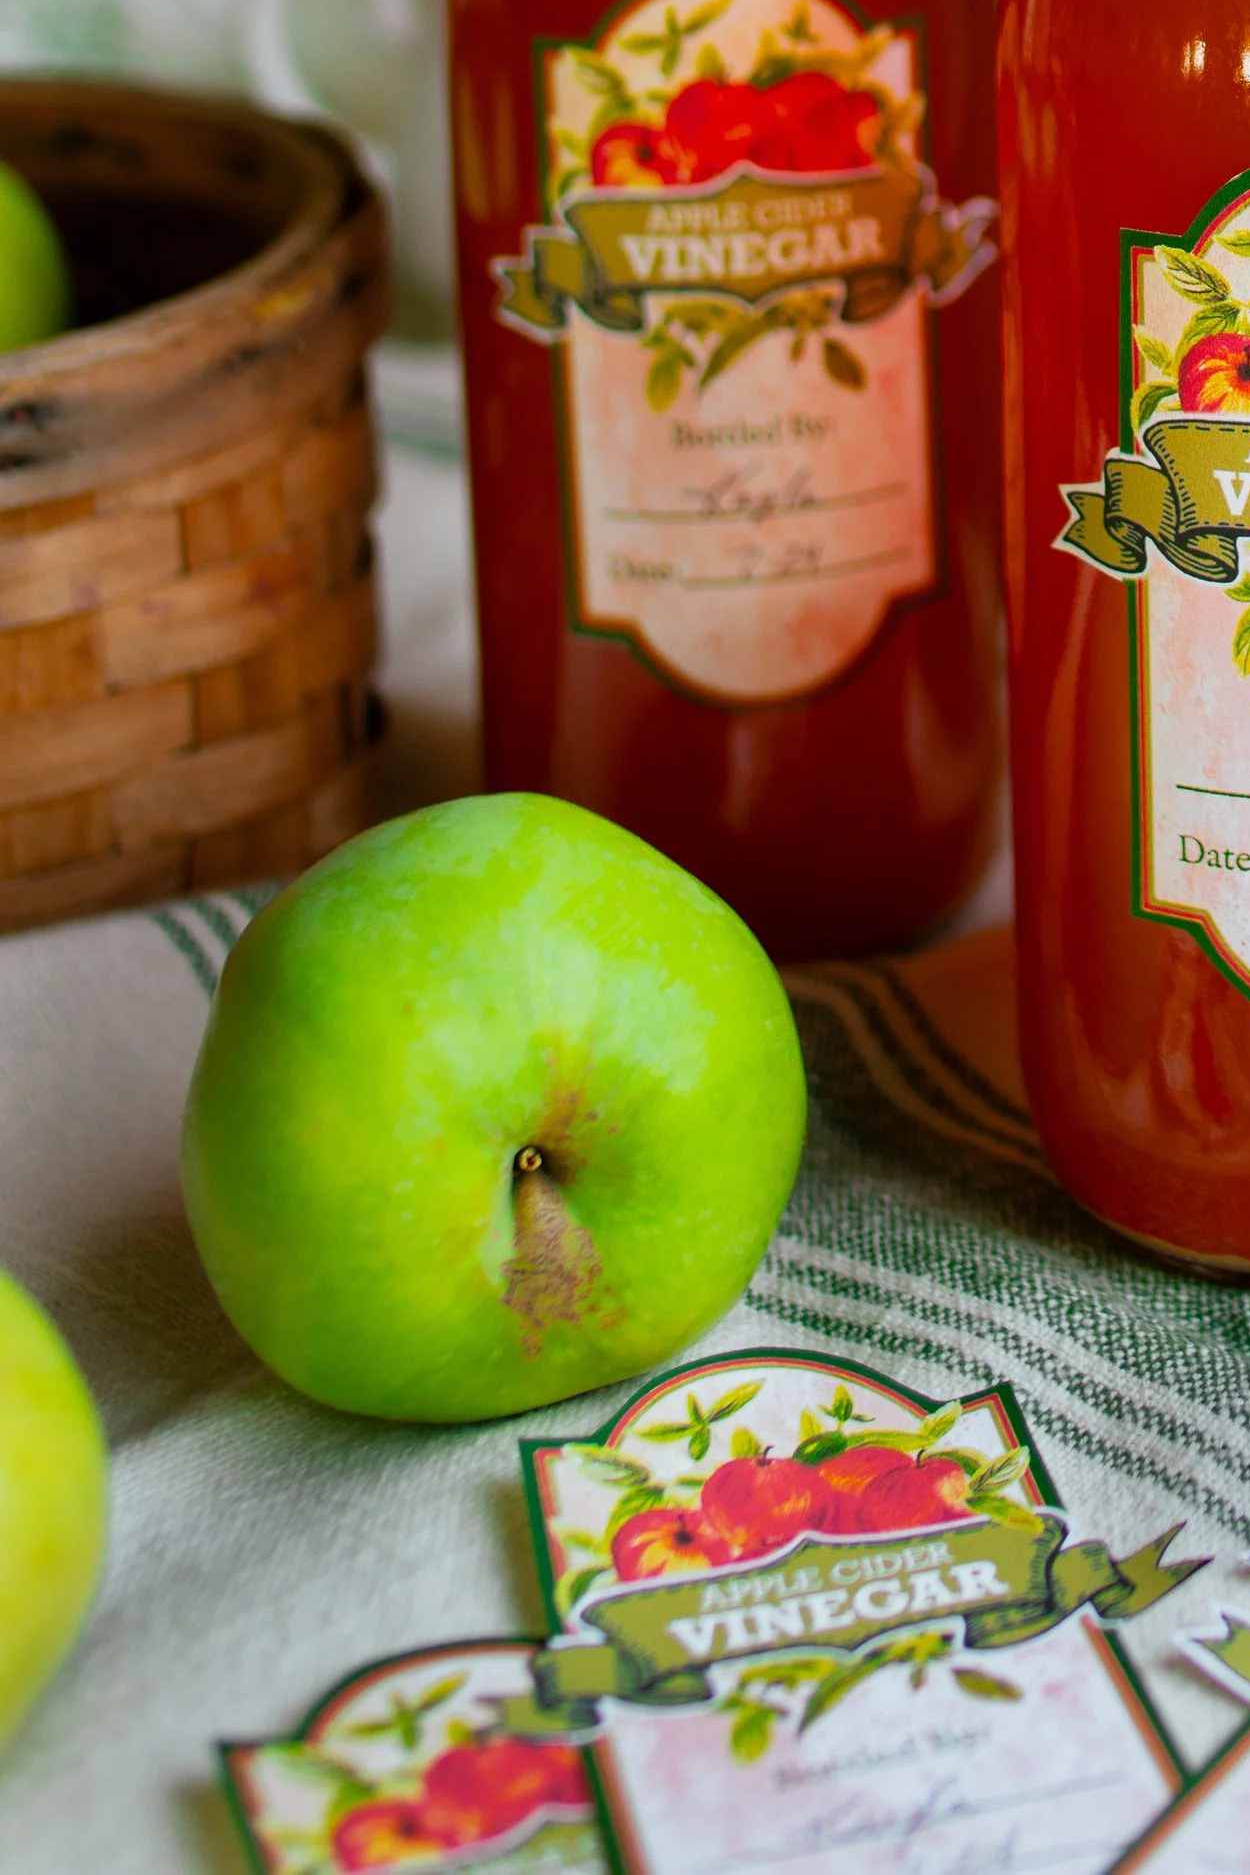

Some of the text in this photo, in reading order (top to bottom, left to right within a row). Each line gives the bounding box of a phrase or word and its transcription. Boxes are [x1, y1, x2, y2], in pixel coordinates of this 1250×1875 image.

[620, 218, 884, 281] VINEGAR
[666, 1559, 1009, 1659] VINEGAR
[702, 1541, 953, 1611] APPLE CIDER
